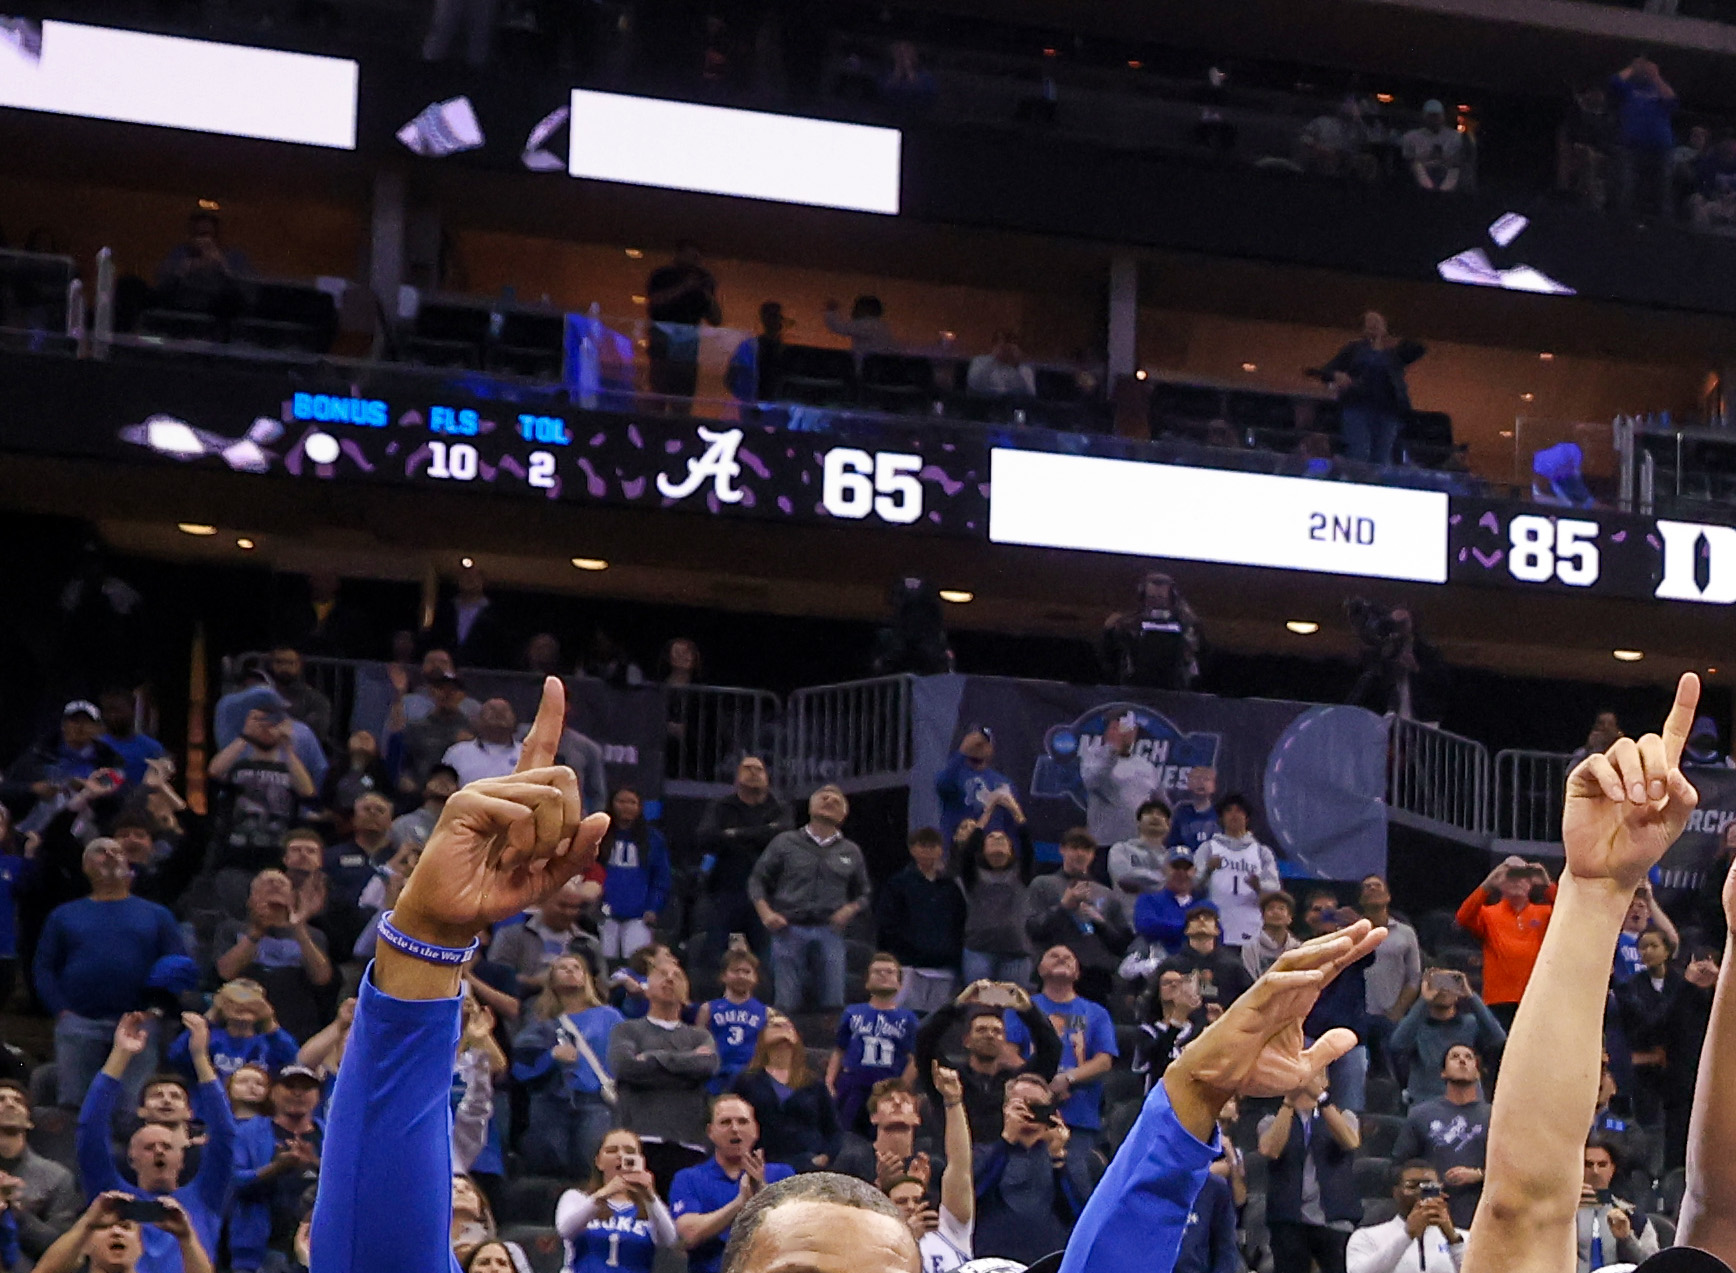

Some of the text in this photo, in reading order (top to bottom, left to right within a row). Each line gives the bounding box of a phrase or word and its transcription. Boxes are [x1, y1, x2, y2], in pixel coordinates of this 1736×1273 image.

[294, 393, 388, 427] BONUS
[429, 406, 479, 435] FLS
[519, 415, 570, 444] TOL
[427, 441, 478, 480] 10
[529, 451, 556, 487] 2
[822, 447, 923, 524] 65
[1310, 513, 1375, 545] 2ND
[1508, 514, 1599, 586] 85
[1220, 857, 1258, 874] Duke
[1233, 875, 1239, 896] 1
[420, 947, 439, 960] the
[440, 951, 462, 963] Way
[713, 1010, 760, 1028] DUKE
[727, 1026, 745, 1046] 3
